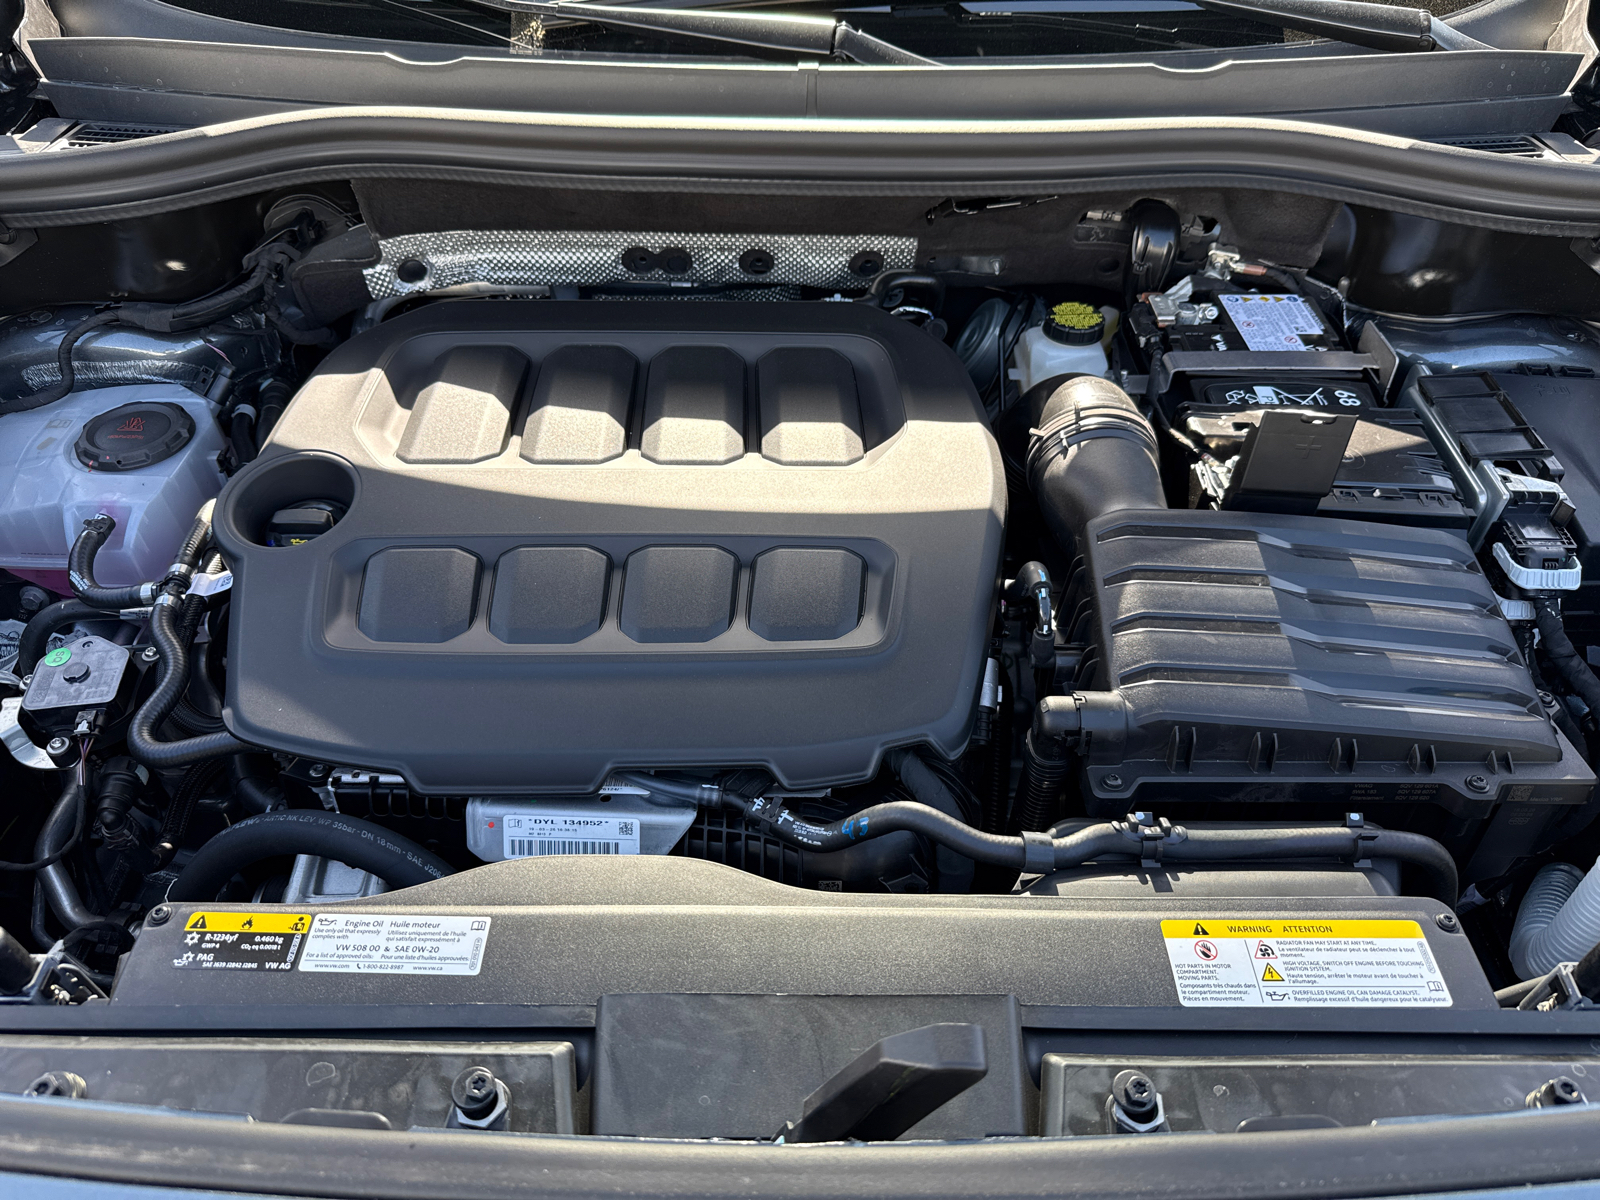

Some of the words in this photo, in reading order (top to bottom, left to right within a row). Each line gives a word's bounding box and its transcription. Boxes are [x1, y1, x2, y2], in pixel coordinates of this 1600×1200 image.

[1334, 390, 1361, 406] 68
[332, 822, 356, 834] 35bar
[361, 830, 374, 841] DN
[407, 851, 423, 867] SAE
[345, 920, 371, 928] Engine
[204, 934, 239, 943] R-1234yf
[275, 936, 284, 944] kg
